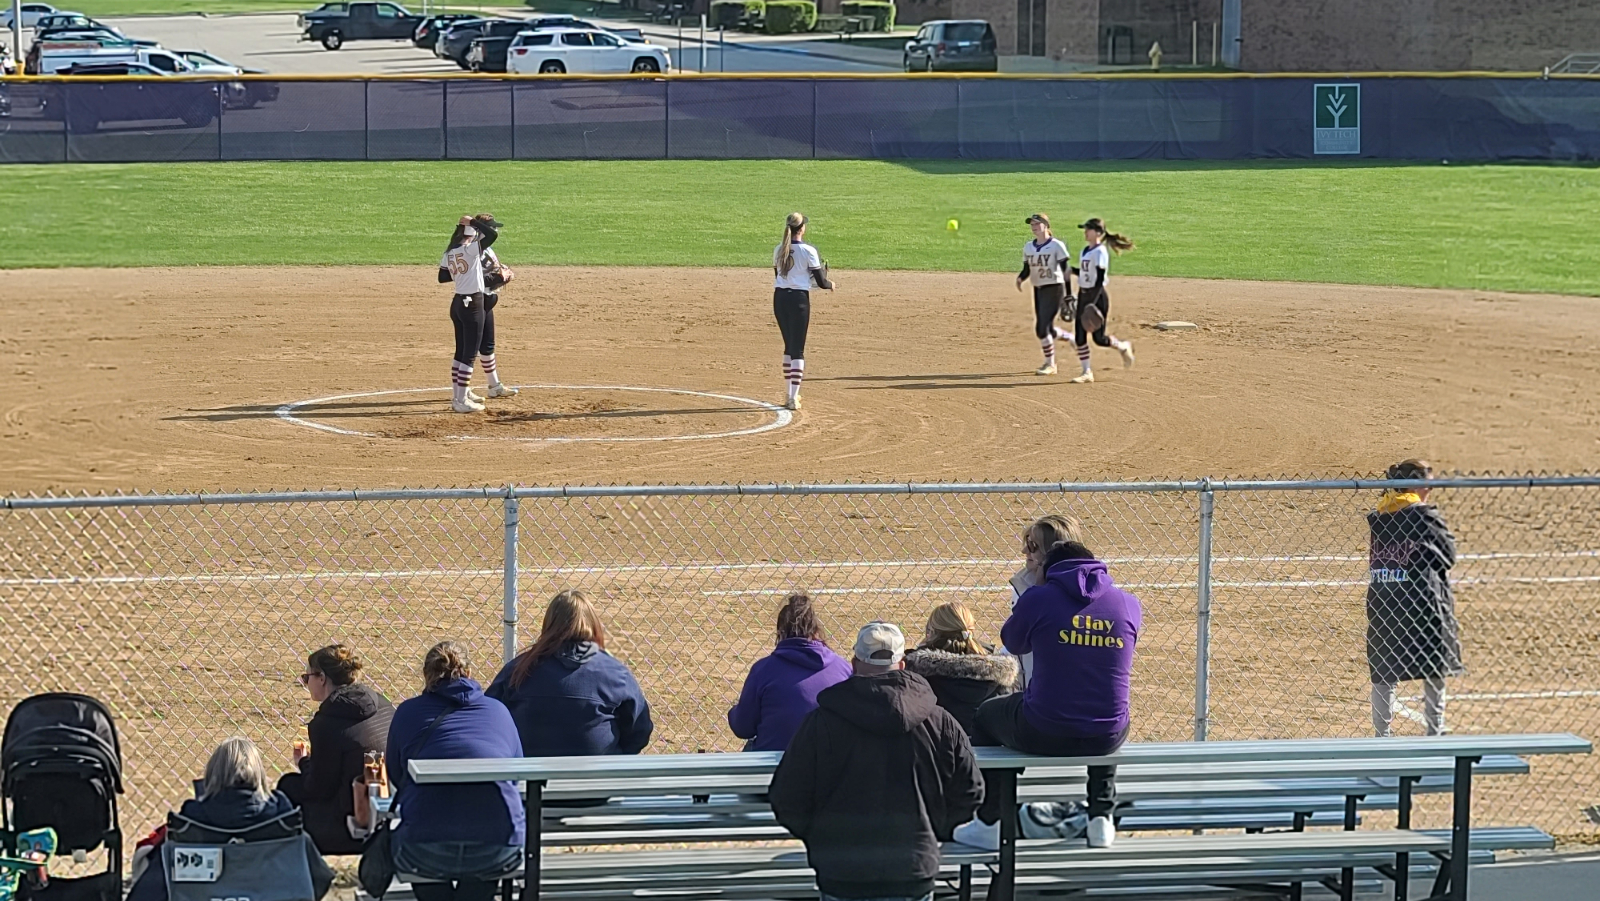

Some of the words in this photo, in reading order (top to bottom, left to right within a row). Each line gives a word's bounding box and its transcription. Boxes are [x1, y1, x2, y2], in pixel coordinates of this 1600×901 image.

[1317, 130, 1331, 139] IVY
[1333, 130, 1356, 139] TECH
[448, 252, 469, 275] 55
[1072, 614, 1115, 634] Clay
[1058, 629, 1125, 649] Shines
